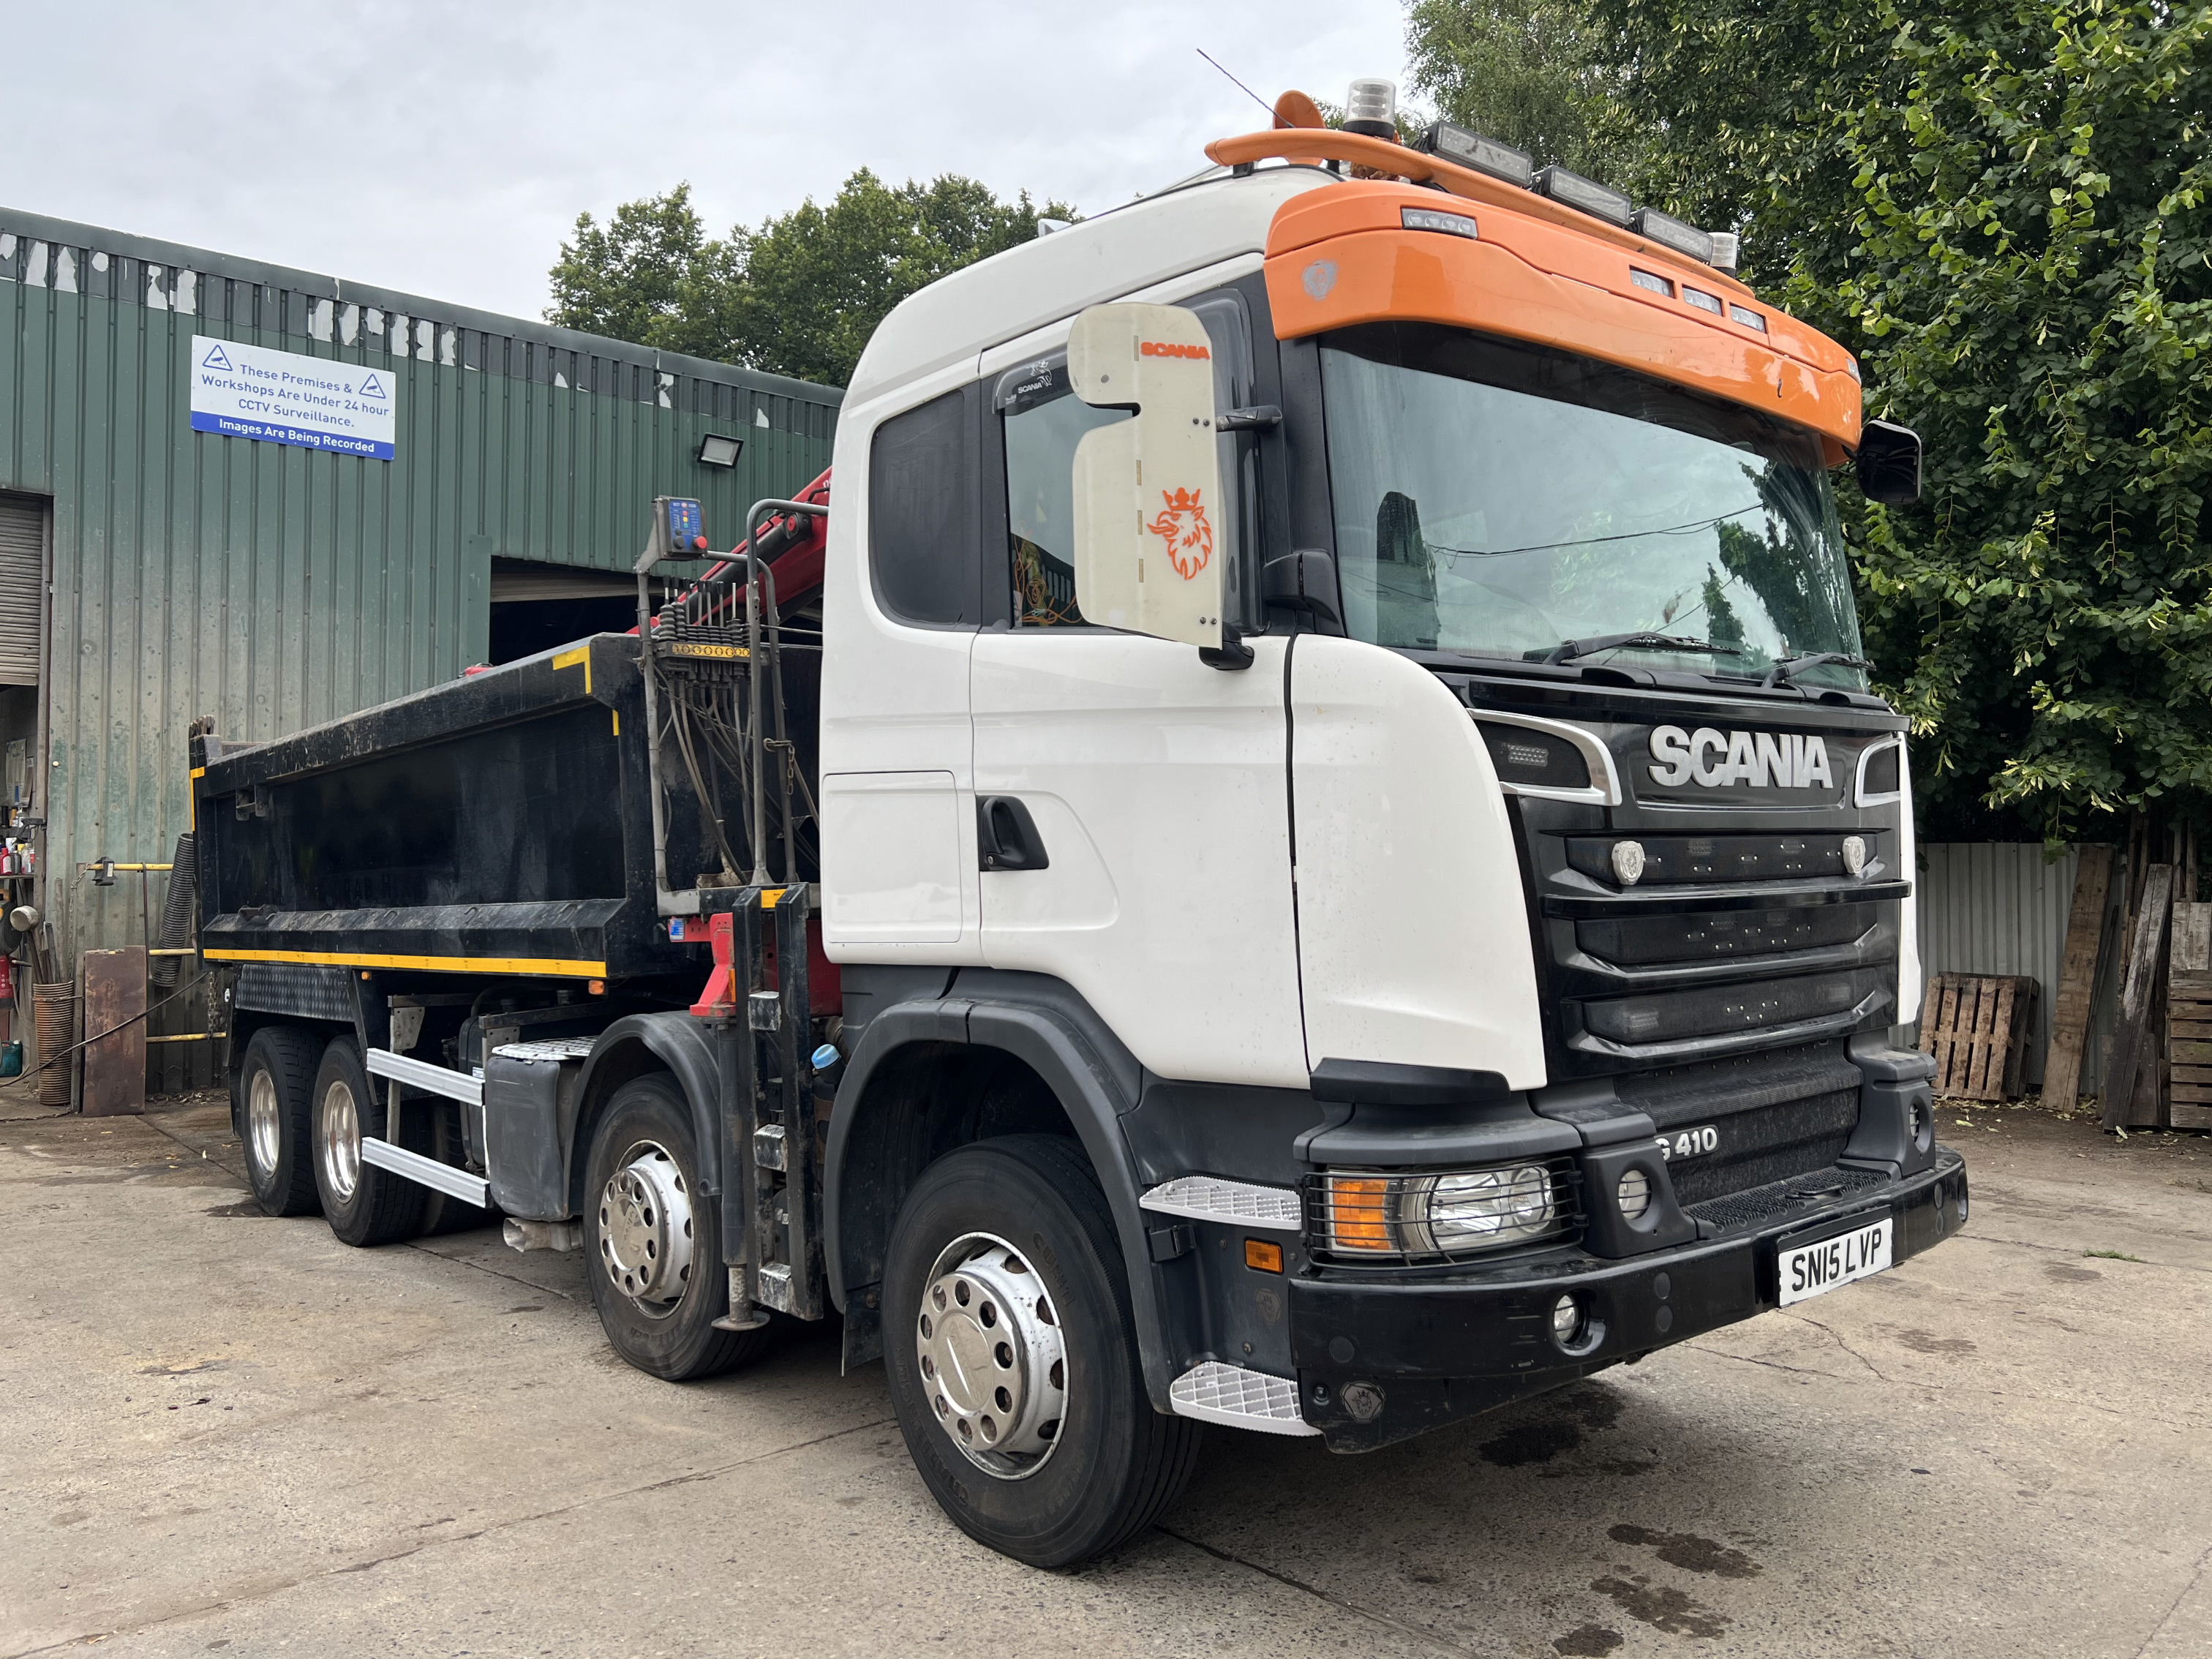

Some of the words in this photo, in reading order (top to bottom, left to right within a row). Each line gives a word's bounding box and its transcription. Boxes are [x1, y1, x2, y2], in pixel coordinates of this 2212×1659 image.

[1140, 342, 1211, 360] SCANIA
[240, 364, 278, 380] These
[282, 372, 340, 392] Premises
[344, 383, 353, 394] &
[1017, 382, 1042, 394] SCANIA
[201, 374, 274, 397] Workshops
[278, 388, 300, 401] Are
[304, 392, 341, 408] Under
[345, 399, 358, 410] 24
[362, 402, 389, 416] hour
[238, 399, 271, 413] CCTV
[274, 405, 355, 427] Surveillance.
[219, 418, 262, 435] Images
[264, 424, 285, 438] Are
[288, 429, 320, 446] Being
[323, 435, 375, 453] Recorded
[1649, 724, 1834, 789] SCANIA
[1674, 1127, 1718, 1156] 410
